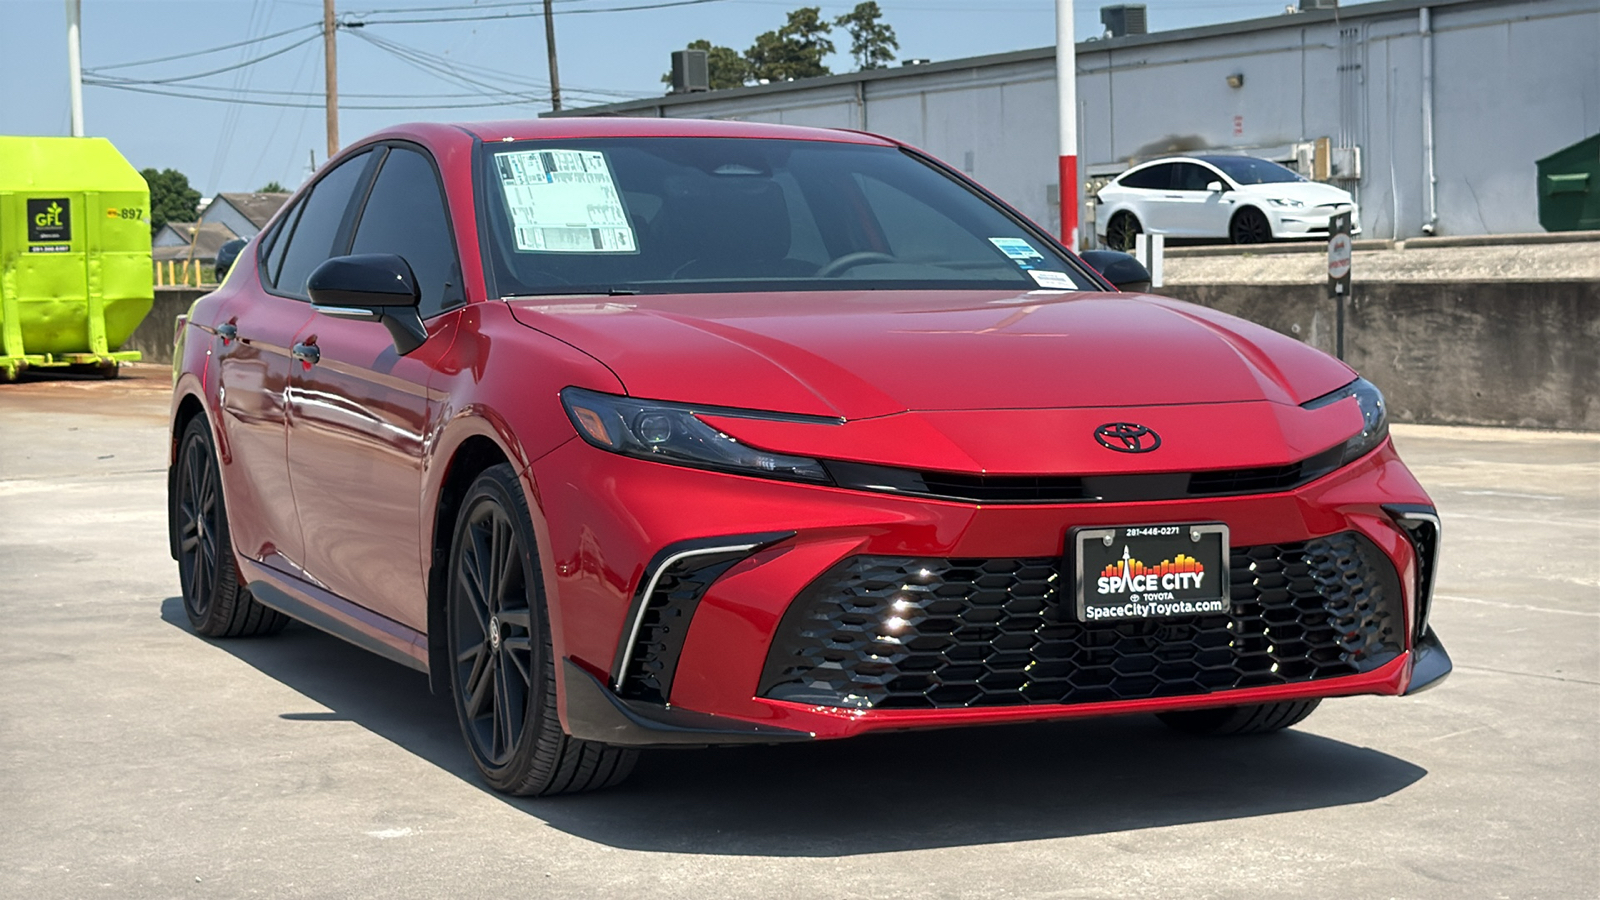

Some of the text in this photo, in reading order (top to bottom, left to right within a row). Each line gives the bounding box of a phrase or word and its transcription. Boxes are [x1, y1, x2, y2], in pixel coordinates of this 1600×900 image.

[35, 211, 63, 227] GFL
[1097, 567, 1205, 594] SPACE CITY
[1143, 592, 1174, 602] TOYOTA
[1086, 600, 1222, 620] SpaceCityToyota.com
